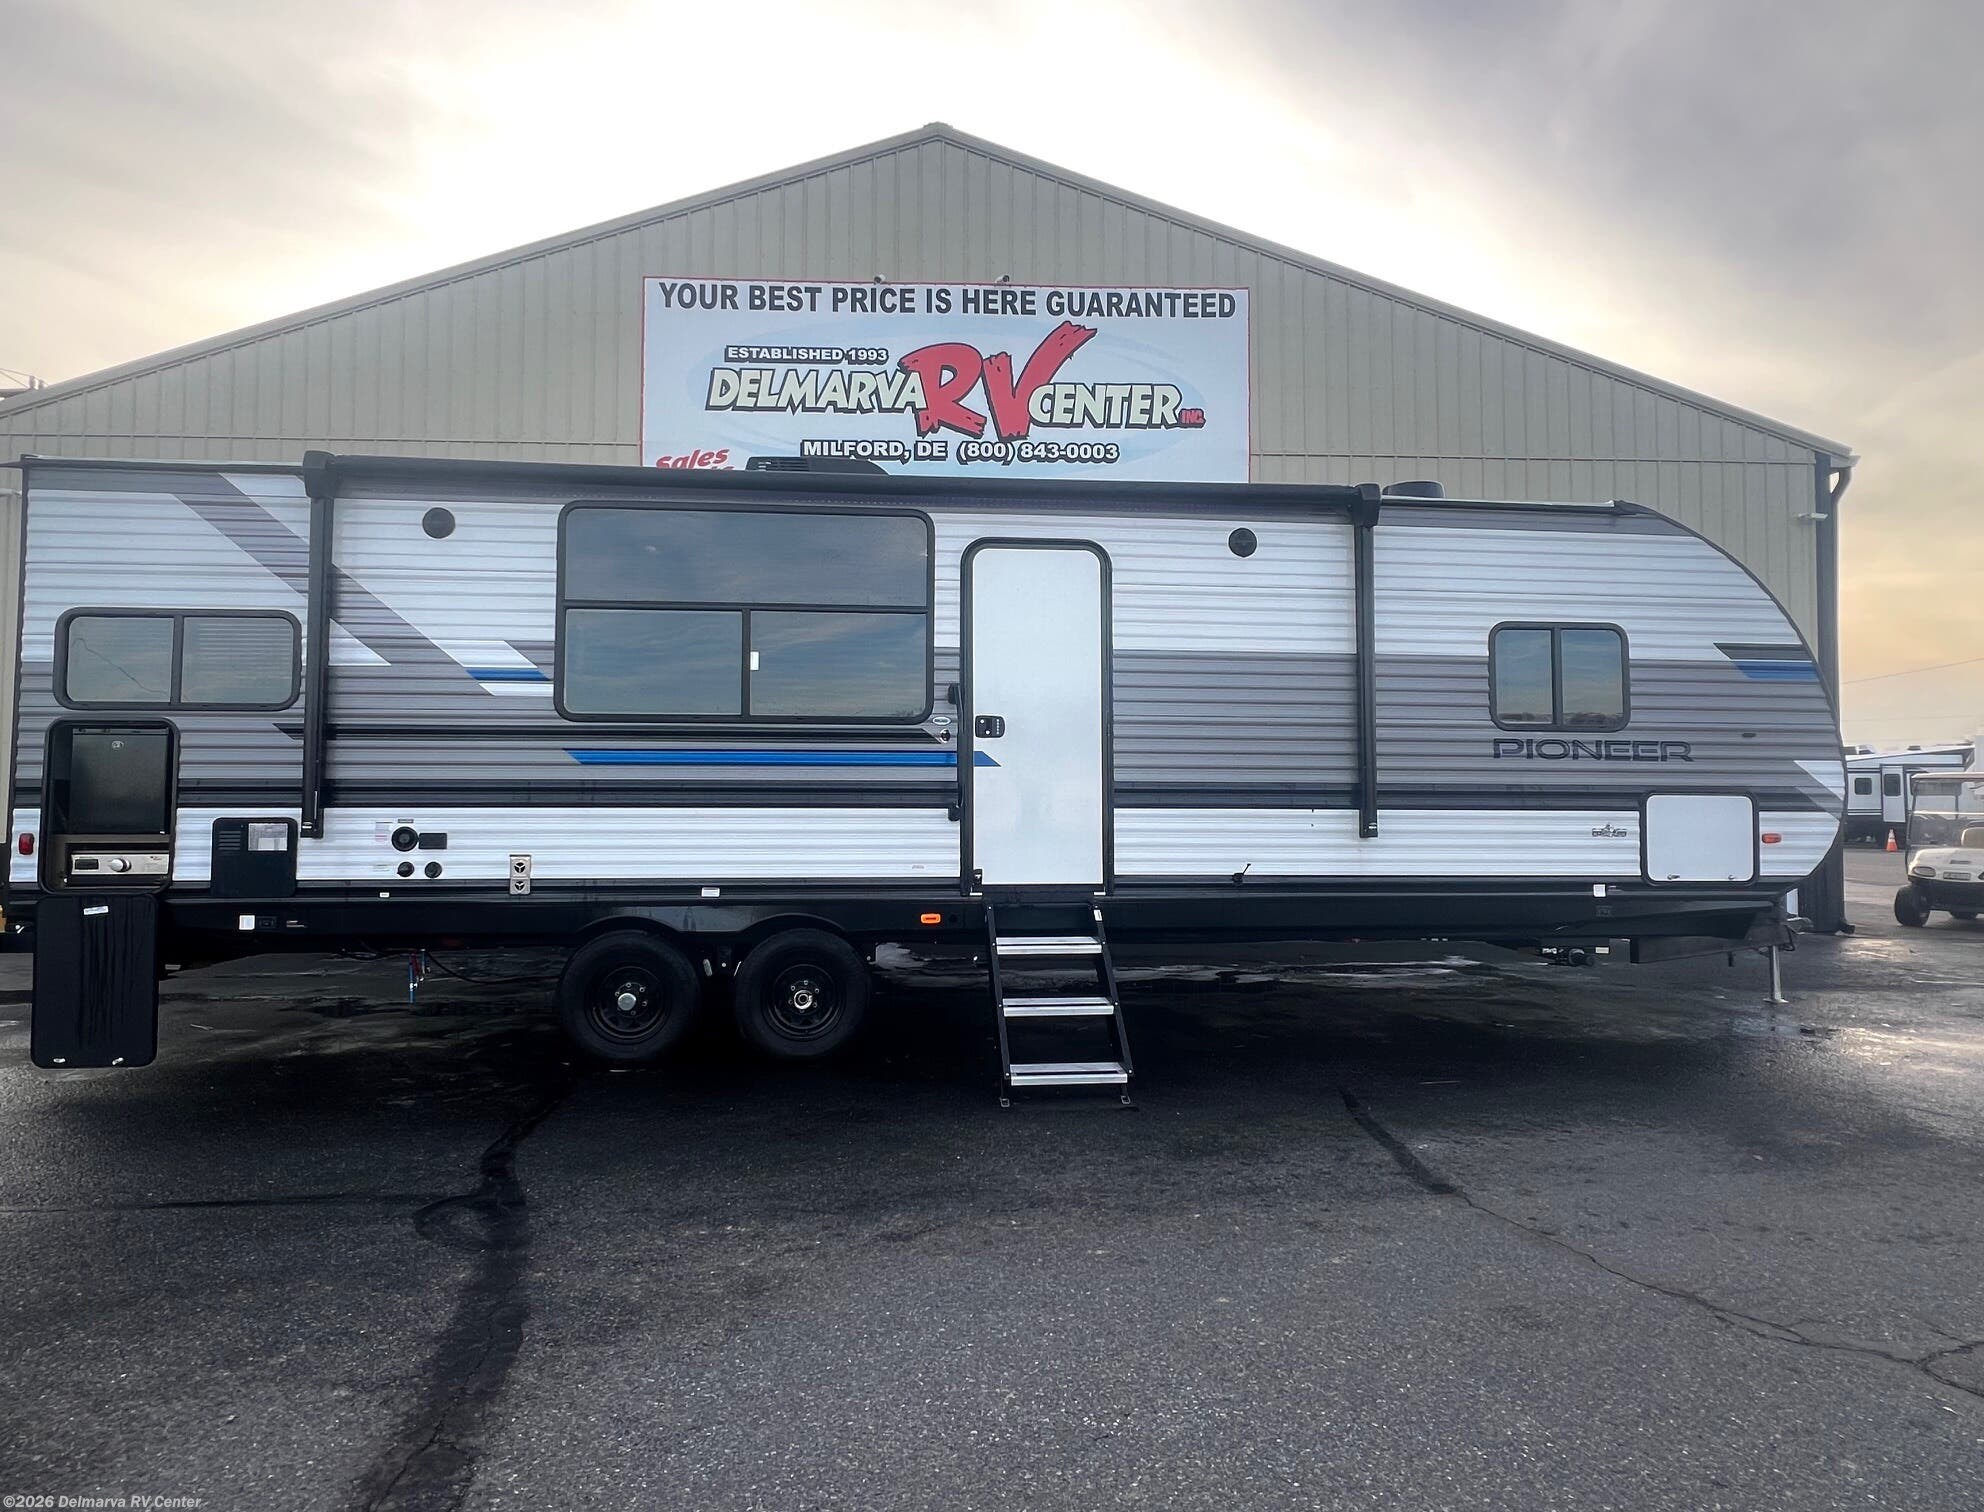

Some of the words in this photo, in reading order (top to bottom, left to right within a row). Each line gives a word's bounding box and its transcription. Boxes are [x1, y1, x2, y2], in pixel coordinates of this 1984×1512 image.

[658, 282, 739, 310] YOUR
[749, 285, 822, 312] BEST
[832, 287, 915, 313] PRICE
[926, 288, 951, 314] IS
[962, 289, 1036, 315] HERE
[1046, 291, 1236, 318] GUARANTEED
[725, 346, 844, 363] ESTABLISHED
[847, 348, 889, 364] 1993
[706, 367, 928, 414] DELMARVA
[898, 320, 1097, 440] RV
[1027, 383, 1182, 429] CENTER
[801, 440, 911, 460] MILFORD,
[914, 441, 947, 458] DE
[957, 442, 1014, 465] (800)
[1018, 442, 1120, 463] 843-0003
[1493, 738, 1694, 762] PIONEER
